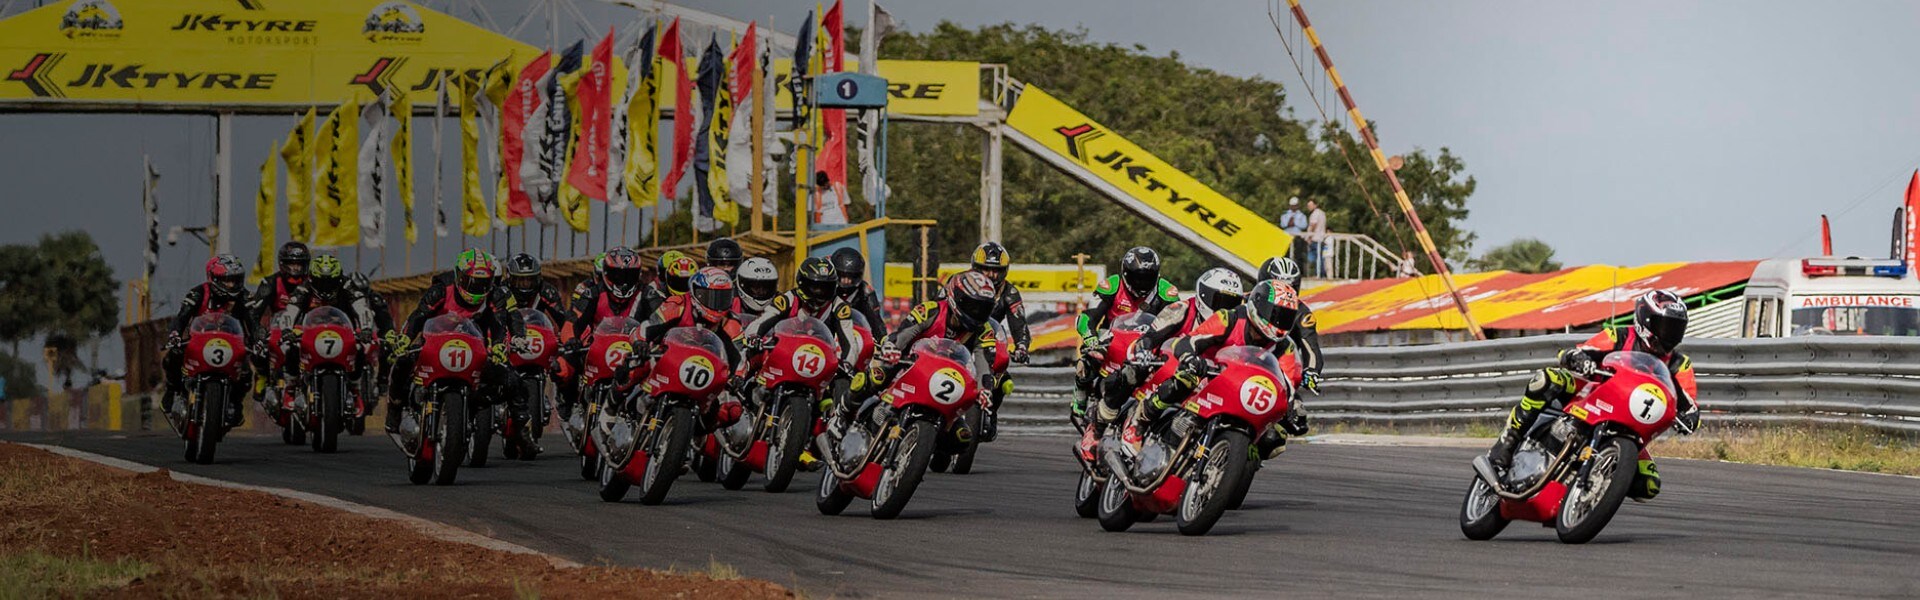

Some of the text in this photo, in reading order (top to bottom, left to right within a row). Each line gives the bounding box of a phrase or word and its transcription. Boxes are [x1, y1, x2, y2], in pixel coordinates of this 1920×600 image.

[227, 35, 320, 46] MOTORSPORT
[841, 83, 851, 97] 1
[1802, 296, 1914, 307] AMBULANCE
[324, 339, 335, 355] 7
[211, 349, 224, 365] 3
[448, 350, 466, 368] 11
[797, 354, 820, 374] 14
[685, 365, 710, 388] 10
[935, 379, 955, 402] 2
[1246, 386, 1272, 412] 15
[1639, 398, 1655, 419] 1
